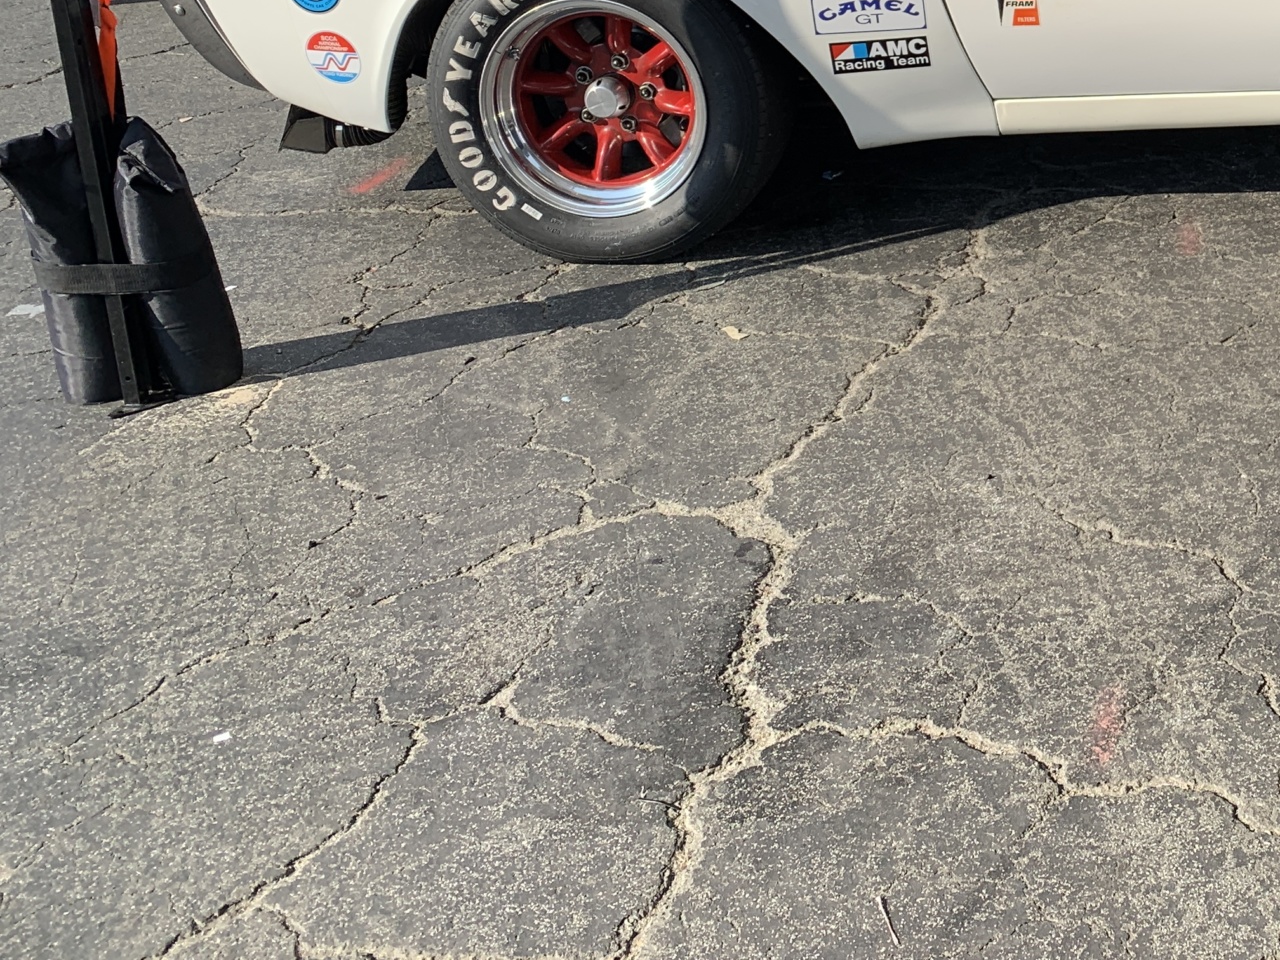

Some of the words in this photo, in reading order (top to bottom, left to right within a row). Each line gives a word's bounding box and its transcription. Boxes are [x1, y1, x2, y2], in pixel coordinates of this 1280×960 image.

[818, 0, 920, 21] CAMEL
[855, 13, 884, 25] GT
[869, 39, 927, 58] AMC
[835, 59, 885, 71] Racing
[890, 56, 930, 67] Team
